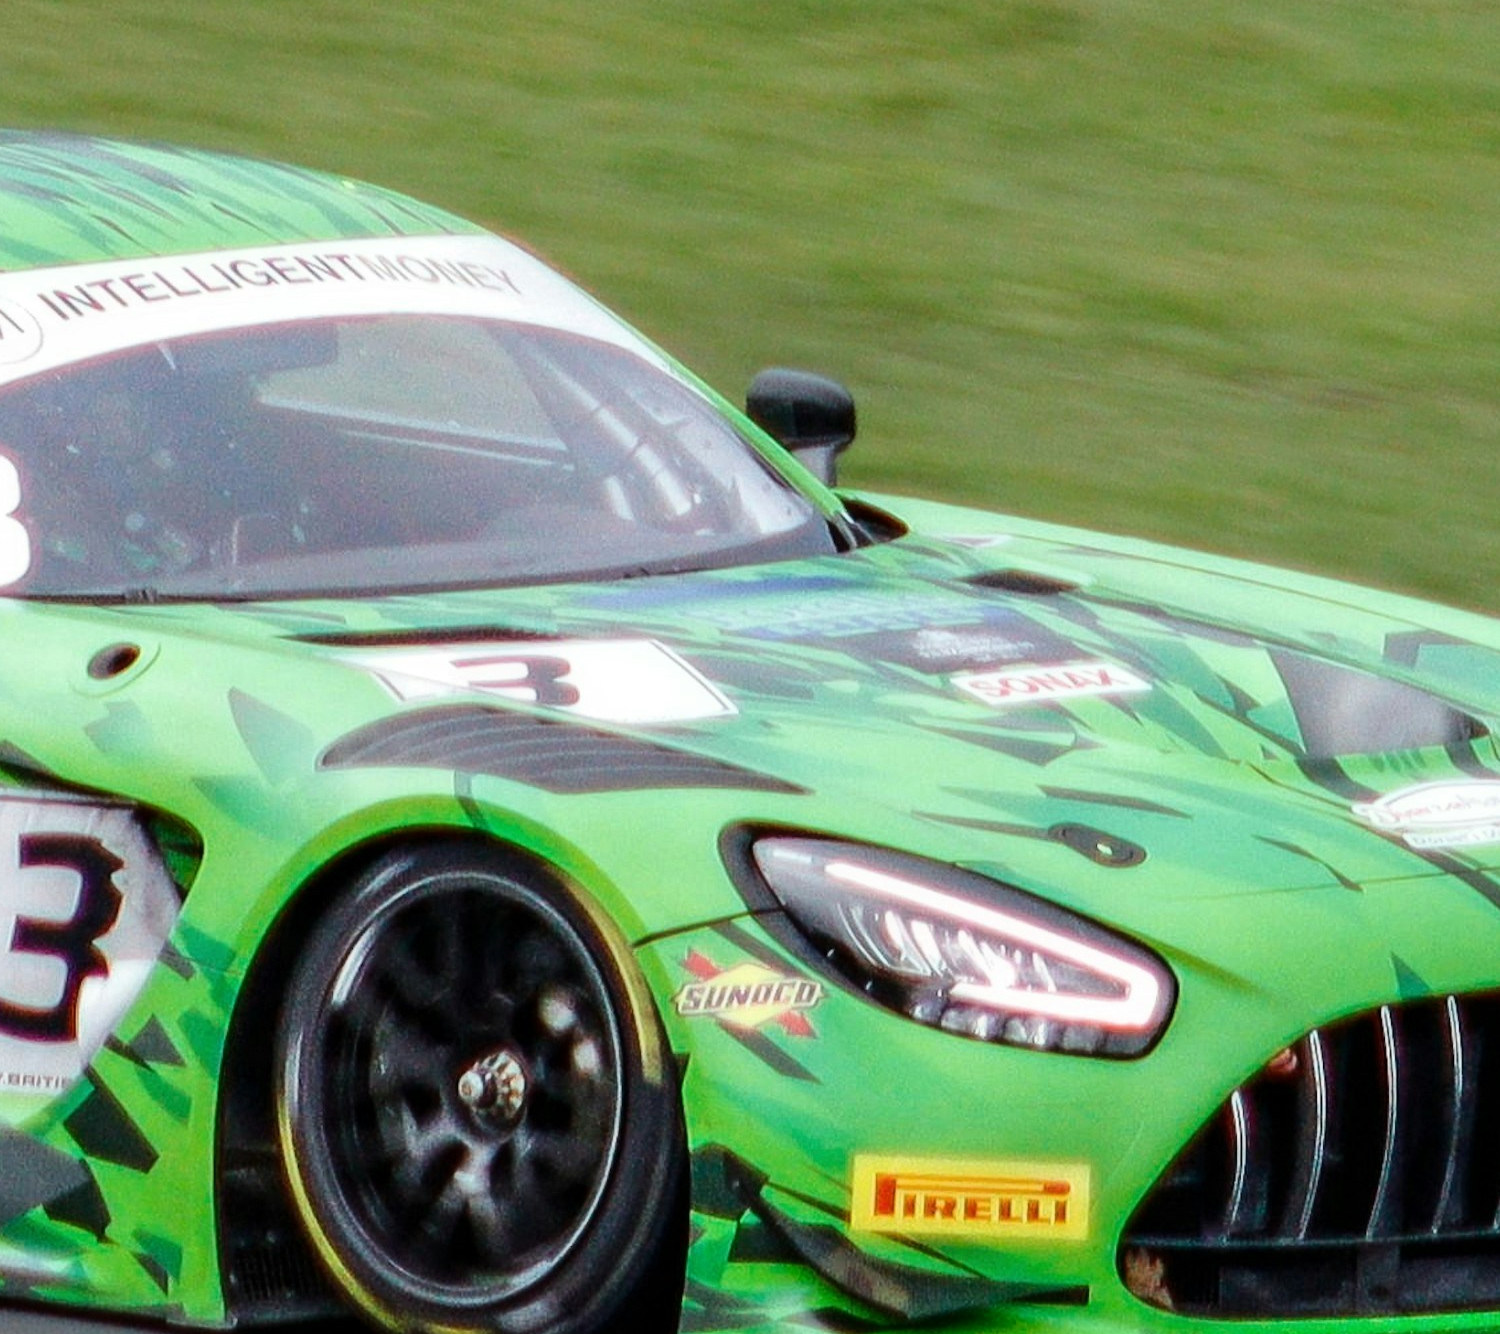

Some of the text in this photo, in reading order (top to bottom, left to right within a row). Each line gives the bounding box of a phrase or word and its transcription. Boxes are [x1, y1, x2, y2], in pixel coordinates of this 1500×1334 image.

[449, 655, 580, 706] 3
[969, 669, 1129, 697] SONAX
[679, 981, 821, 1012] SUNOCO
[874, 1172, 1071, 1225] PIRELLI
